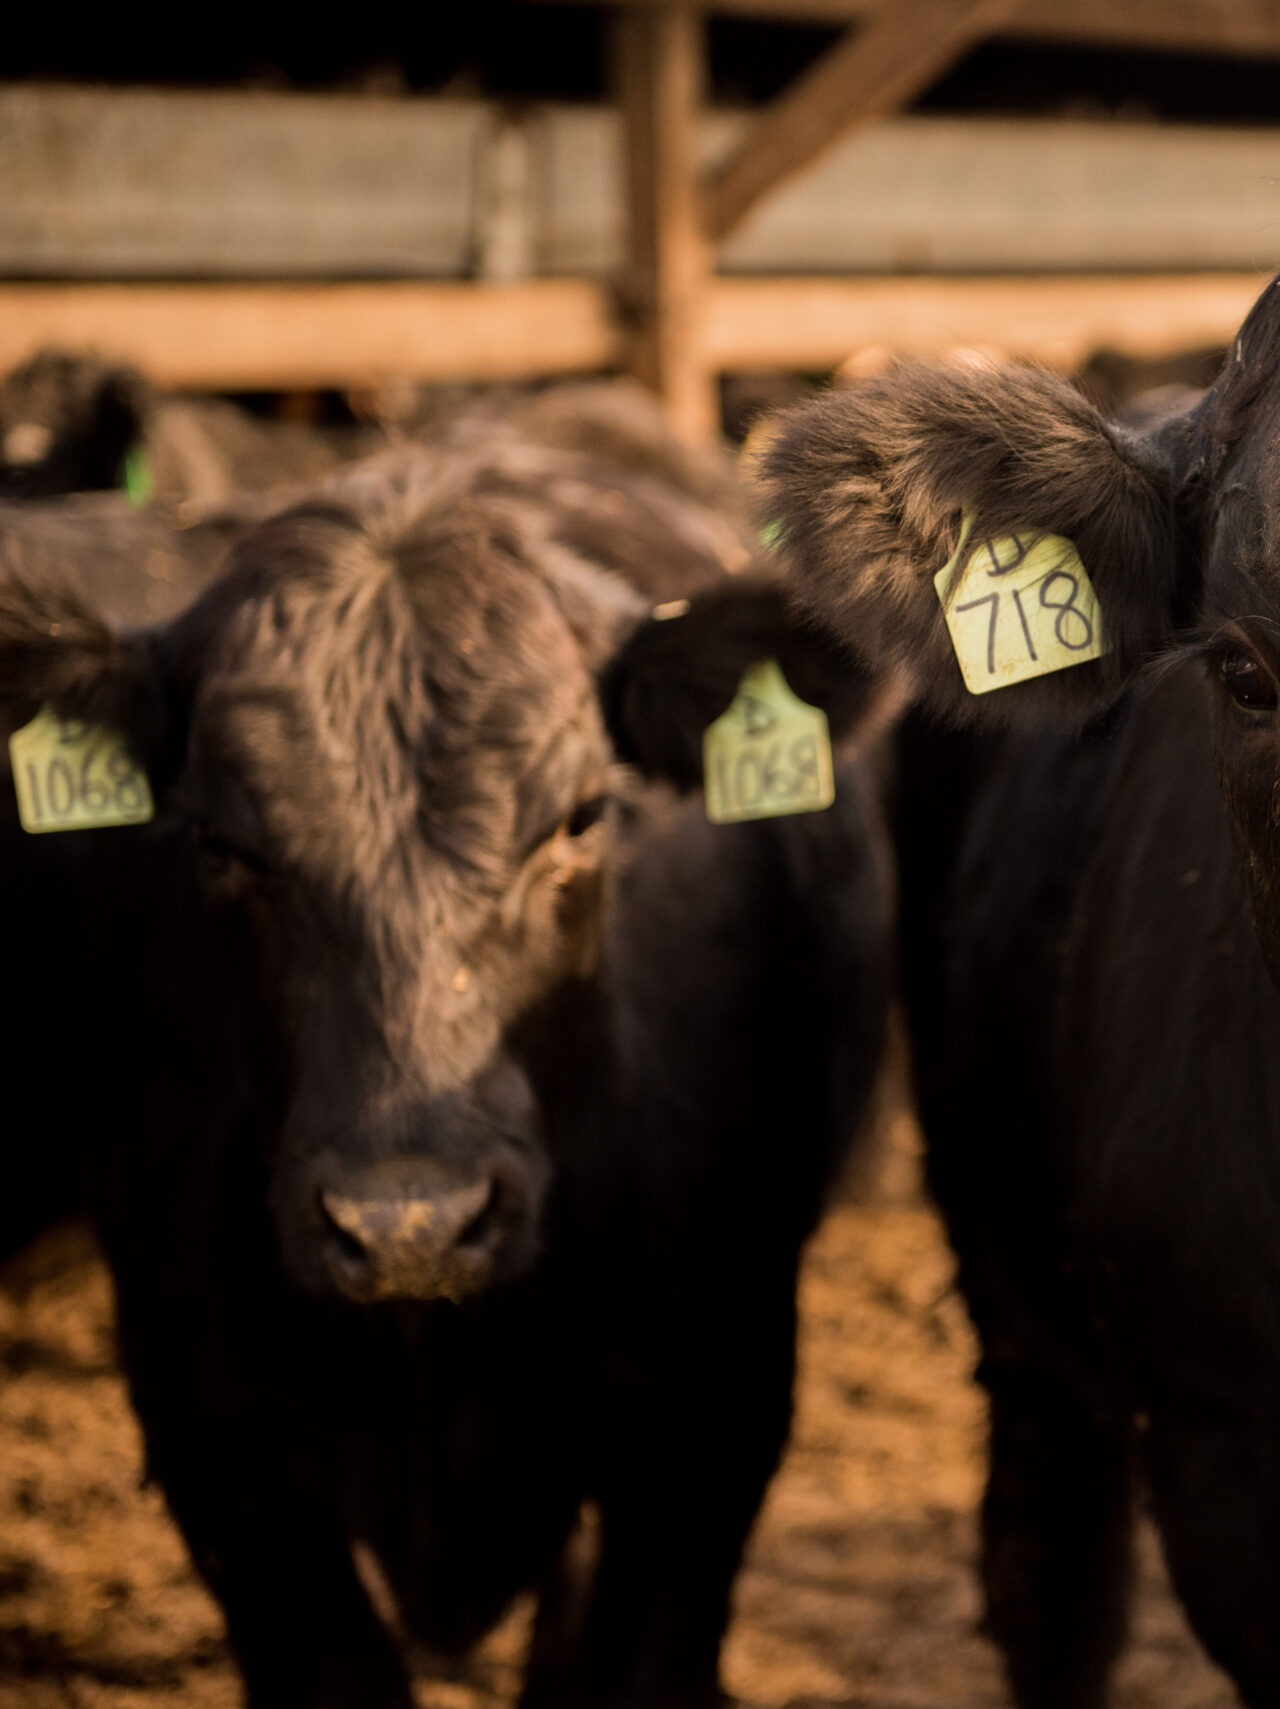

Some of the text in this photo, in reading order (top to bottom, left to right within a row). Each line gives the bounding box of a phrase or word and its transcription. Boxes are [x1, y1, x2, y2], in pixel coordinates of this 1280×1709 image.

[955, 570, 1093, 674] 718
[27, 748, 142, 821] 1068
[716, 731, 822, 811] 1068
